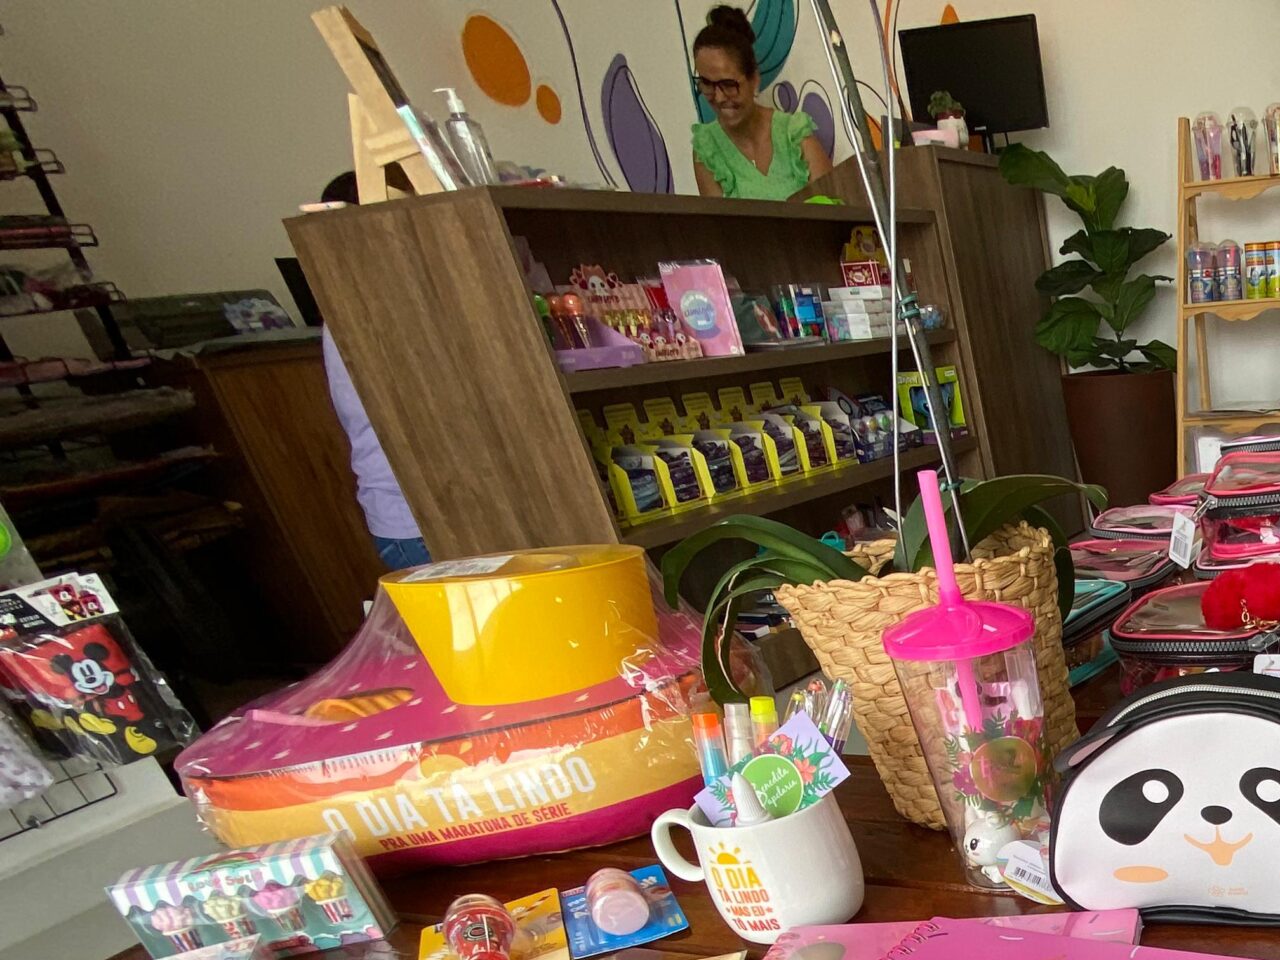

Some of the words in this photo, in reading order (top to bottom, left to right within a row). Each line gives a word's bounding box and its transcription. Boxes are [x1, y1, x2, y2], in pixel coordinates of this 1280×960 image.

[321, 808, 356, 841] O
[354, 793, 428, 838] DIA
[485, 756, 597, 812] LINDO
[379, 832, 410, 850] PRA
[410, 827, 440, 846] UMA
[441, 817, 513, 841] MARATONA
[515, 813, 532, 827] DE
[533, 802, 572, 823] SÉRIE
[710, 867, 723, 888] O
[725, 866, 763, 889] DIA
[733, 888, 770, 903] LINDO
[731, 906, 751, 917] MAS
[752, 905, 766, 917] EU
[749, 919, 781, 932] MAIS
